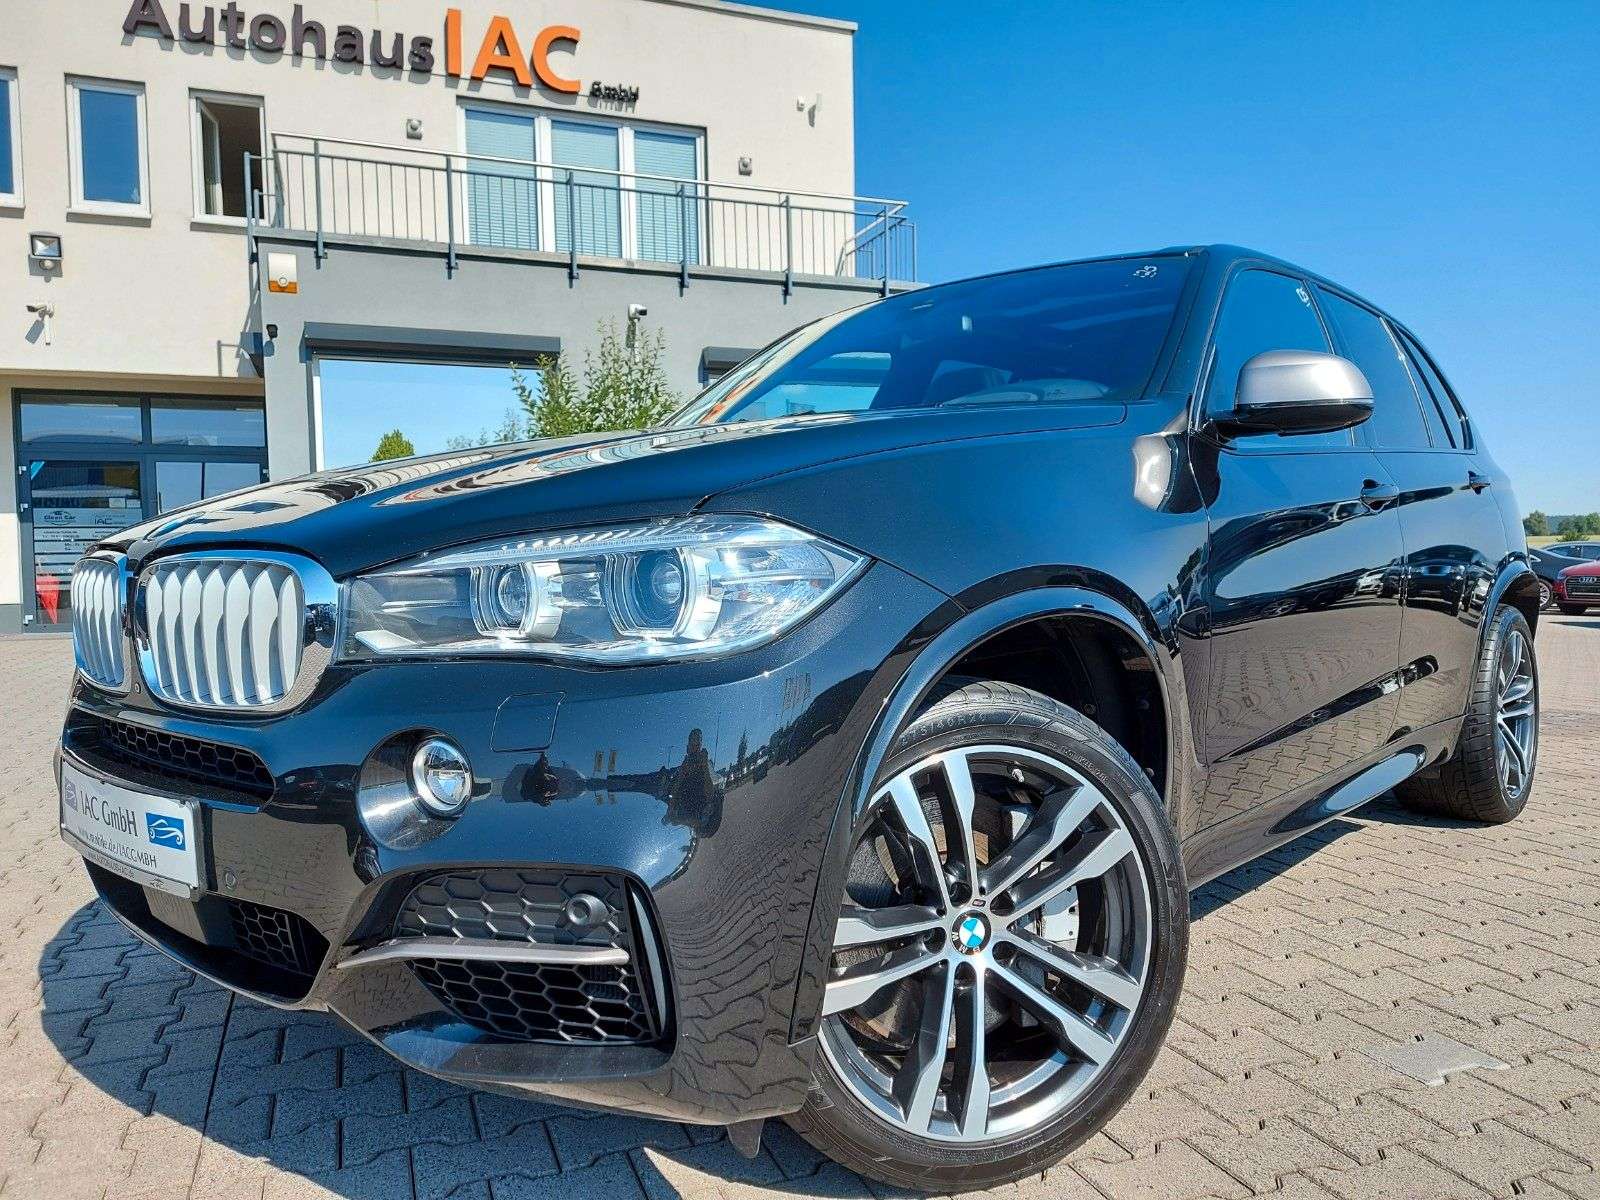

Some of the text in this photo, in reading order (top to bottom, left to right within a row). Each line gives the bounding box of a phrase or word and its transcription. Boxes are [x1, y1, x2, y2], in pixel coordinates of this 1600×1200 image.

[122, 0, 639, 102] Autohaus IAC GmbH
[80, 790, 139, 837] IAC GmbH
